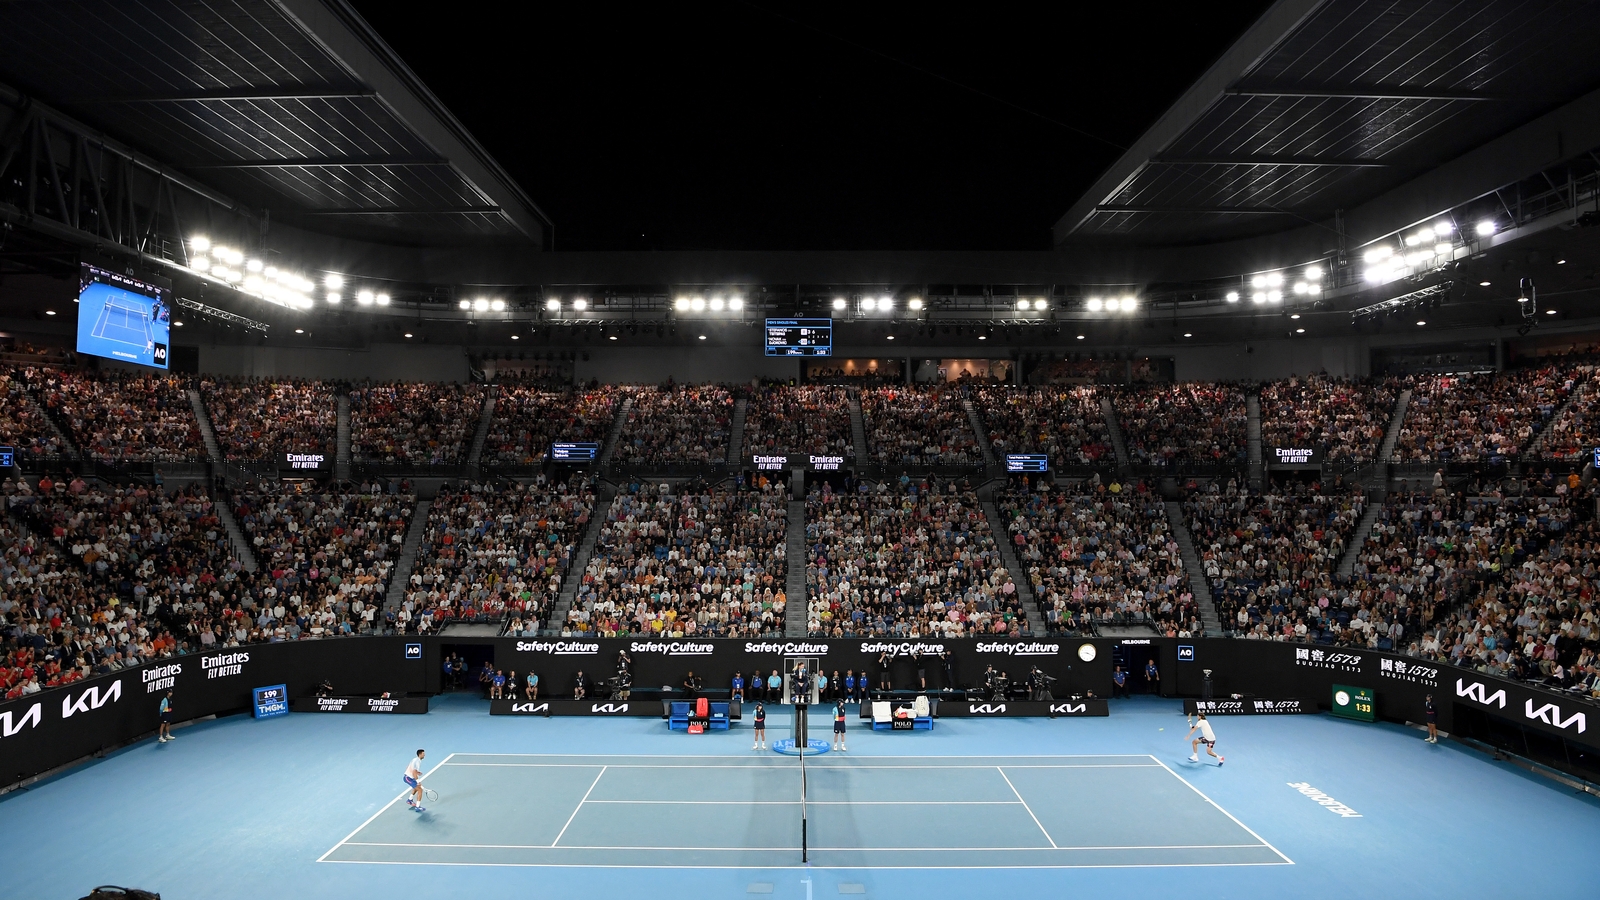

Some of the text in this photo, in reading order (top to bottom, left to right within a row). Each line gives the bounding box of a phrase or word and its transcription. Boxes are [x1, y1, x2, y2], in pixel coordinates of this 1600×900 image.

[112, 350, 137, 359] MELBOURNE
[154, 348, 165, 359] AO
[286, 453, 324, 462] Emirates
[1276, 448, 1313, 456] Emirates
[753, 455, 787, 463] Emirates
[810, 455, 844, 463] Emirates
[516, 641, 599, 655] SafetyCulture
[630, 642, 714, 655] SafetyCulture
[745, 642, 828, 656] SafetyCulture
[860, 642, 944, 656] SafetyCulture
[976, 642, 1059, 656] SafetyCulture
[201, 652, 250, 669] Emirates
[1296, 660, 1335, 669] GUOJIAO
[142, 663, 182, 683] Emirates
[208, 664, 242, 679] FLY BETTER
[147, 676, 175, 693] FLY BETTER
[1381, 671, 1437, 687] GUOJIAO 1573
[62, 679, 122, 718] KIA
[264, 690, 277, 698] 199
[1456, 677, 1506, 710] KIA
[512, 702, 548, 712] KIA
[592, 703, 628, 714] KIA
[970, 703, 1006, 714] KIA
[1050, 703, 1086, 714] KIA
[1356, 703, 1370, 712] 1:33
[1526, 698, 1587, 734] KIA
[1286, 782, 1364, 818] MELBOURNE
